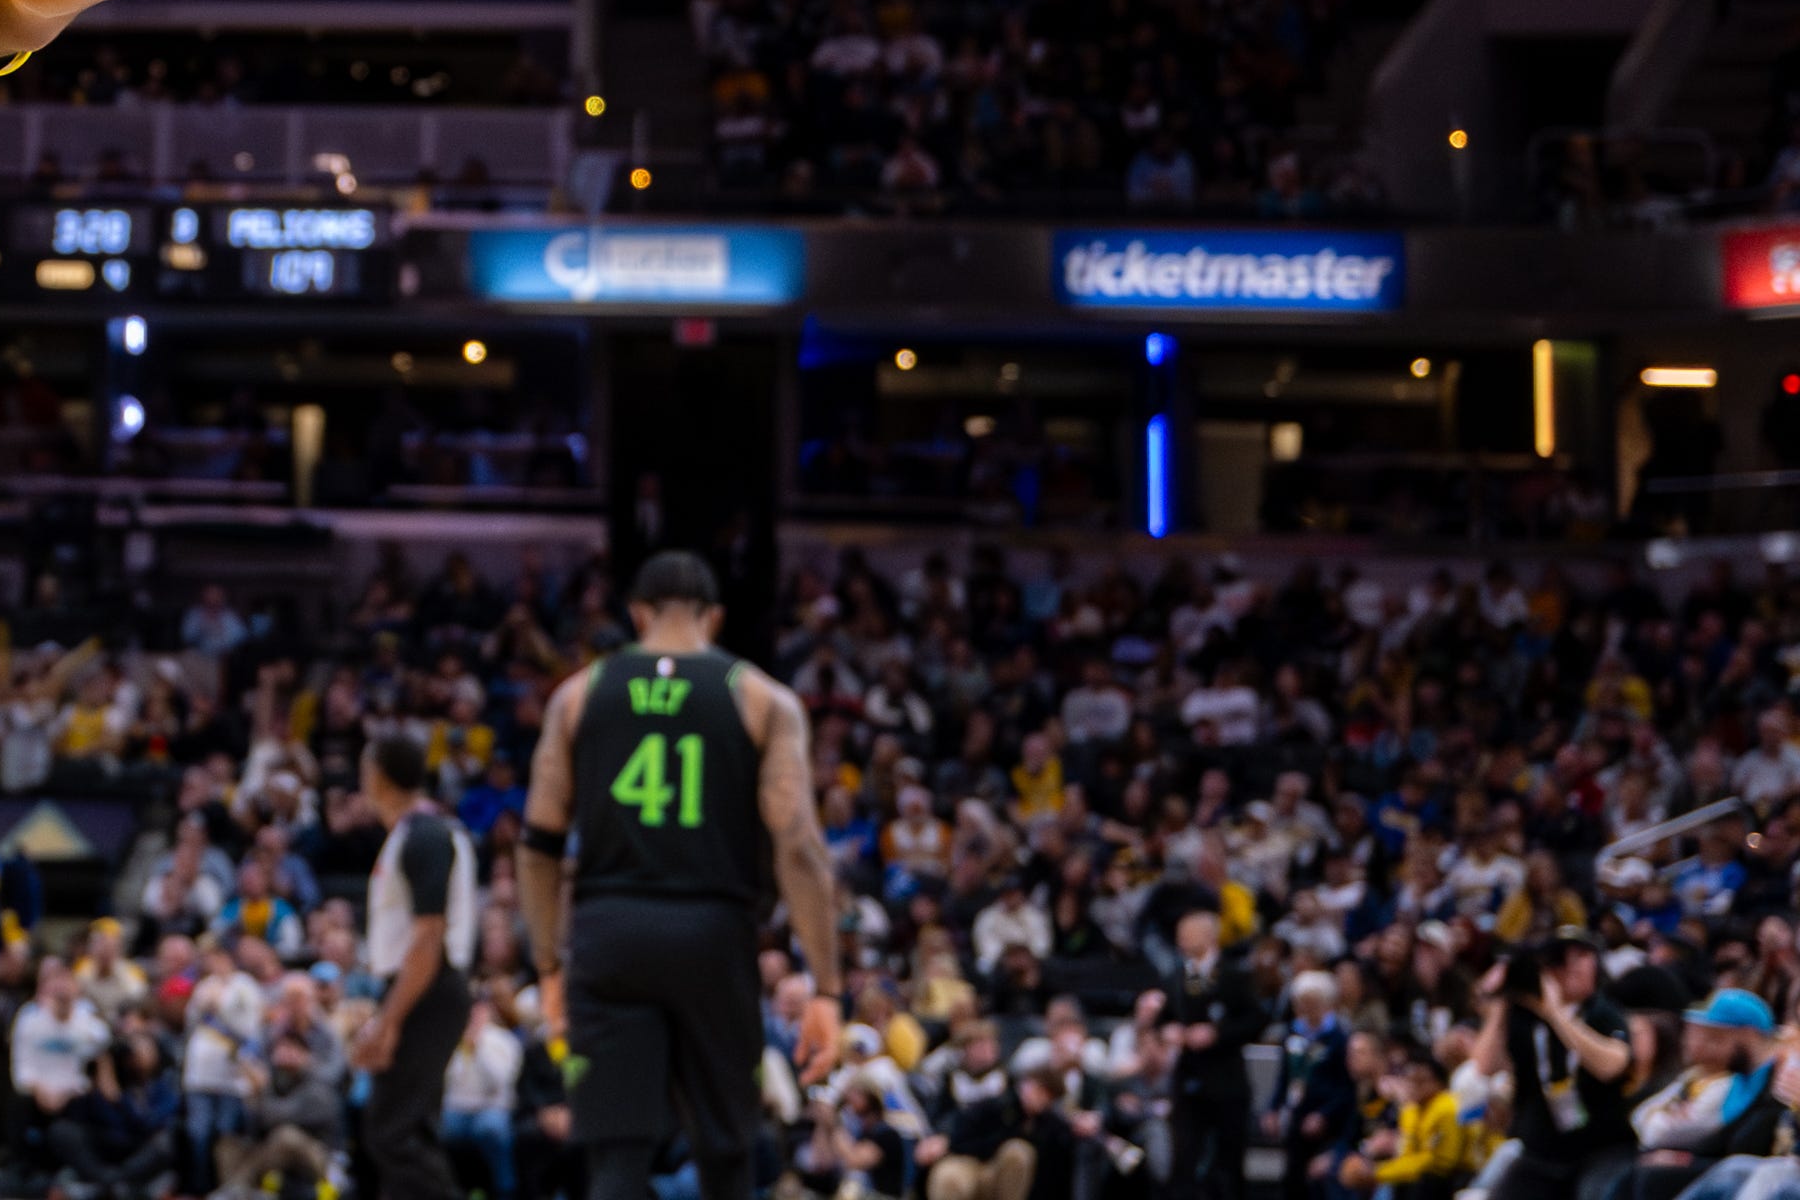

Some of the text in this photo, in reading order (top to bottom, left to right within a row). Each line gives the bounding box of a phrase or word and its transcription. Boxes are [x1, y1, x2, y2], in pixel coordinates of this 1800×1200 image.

[228, 208, 376, 249] PELICANS
[270, 250, 334, 294] 109
[1063, 240, 1394, 300] ticketmaster
[609, 732, 705, 829] 41
